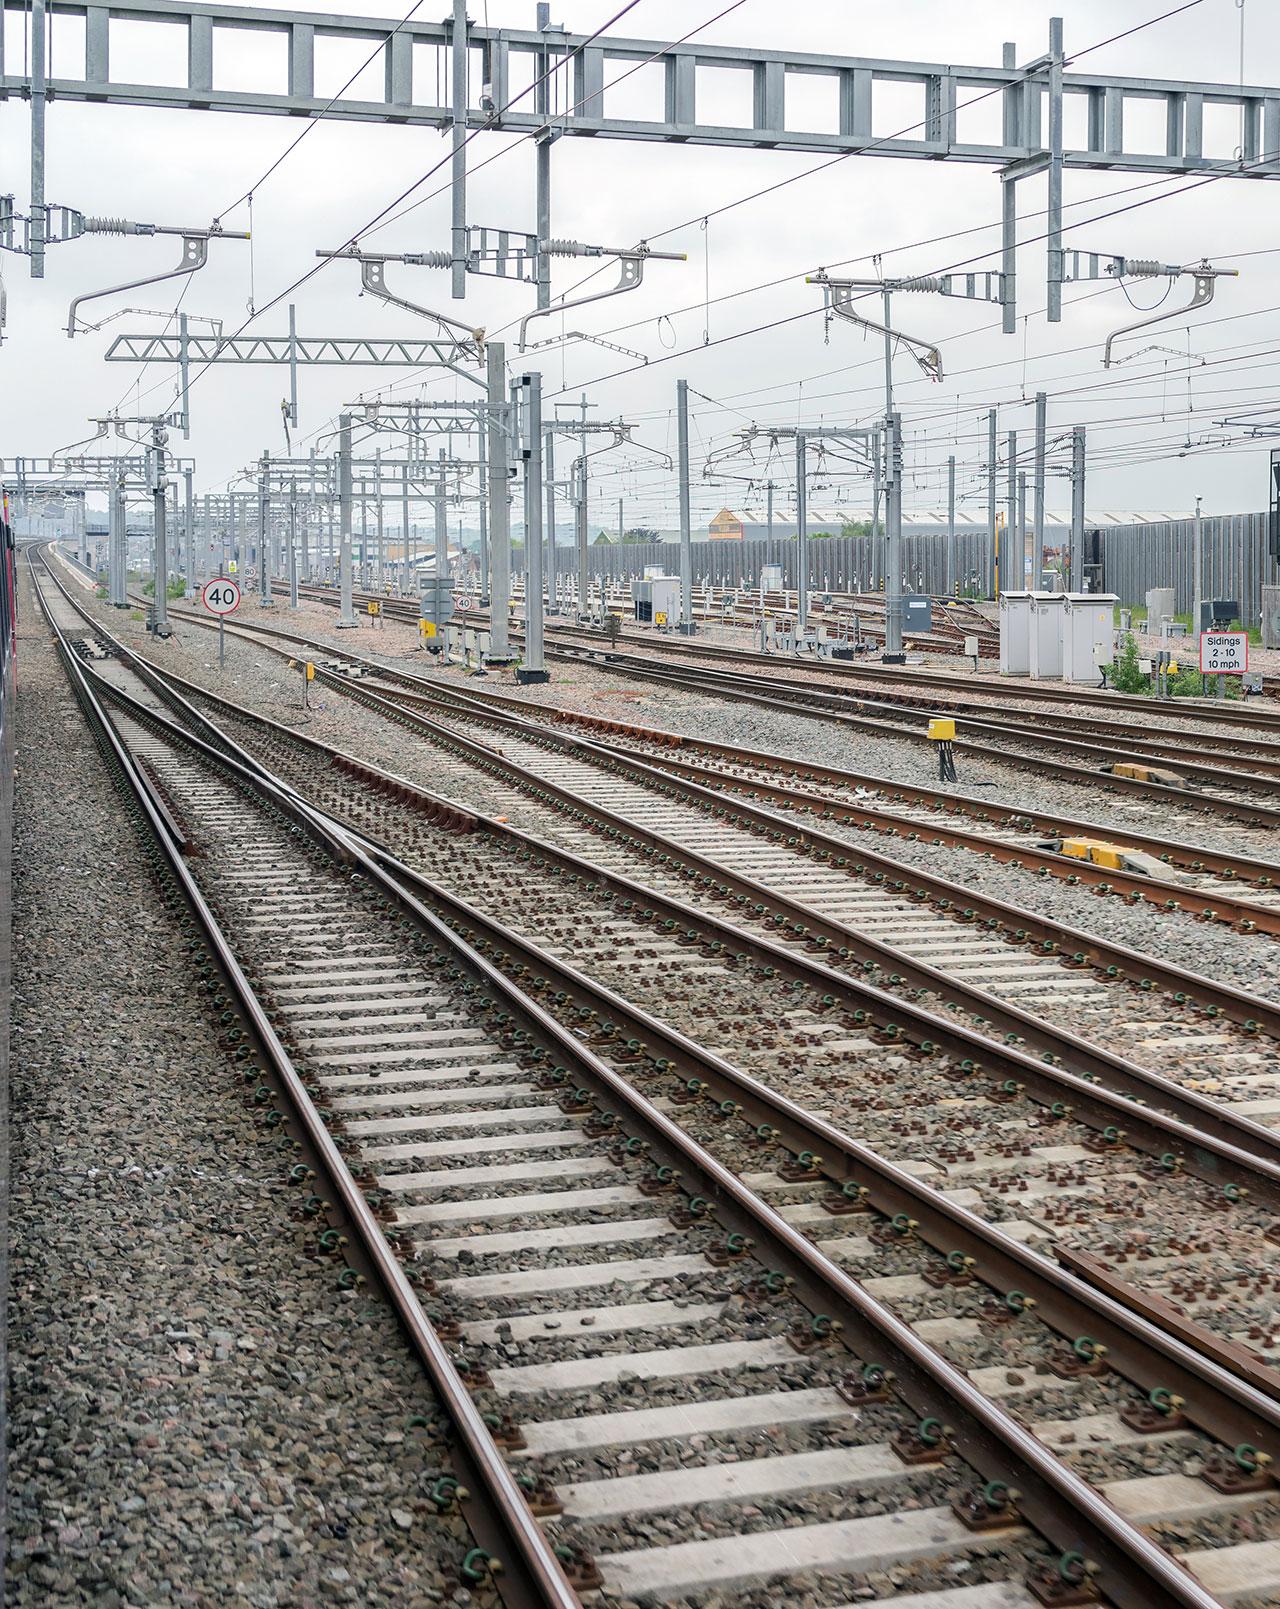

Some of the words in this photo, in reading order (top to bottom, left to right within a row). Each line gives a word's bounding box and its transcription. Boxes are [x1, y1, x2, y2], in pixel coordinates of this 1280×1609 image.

[209, 588, 234, 604] 40
[1207, 637, 1240, 646] Sidings
[1208, 660, 1218, 668] 10
[1220, 660, 1240, 669] mph
